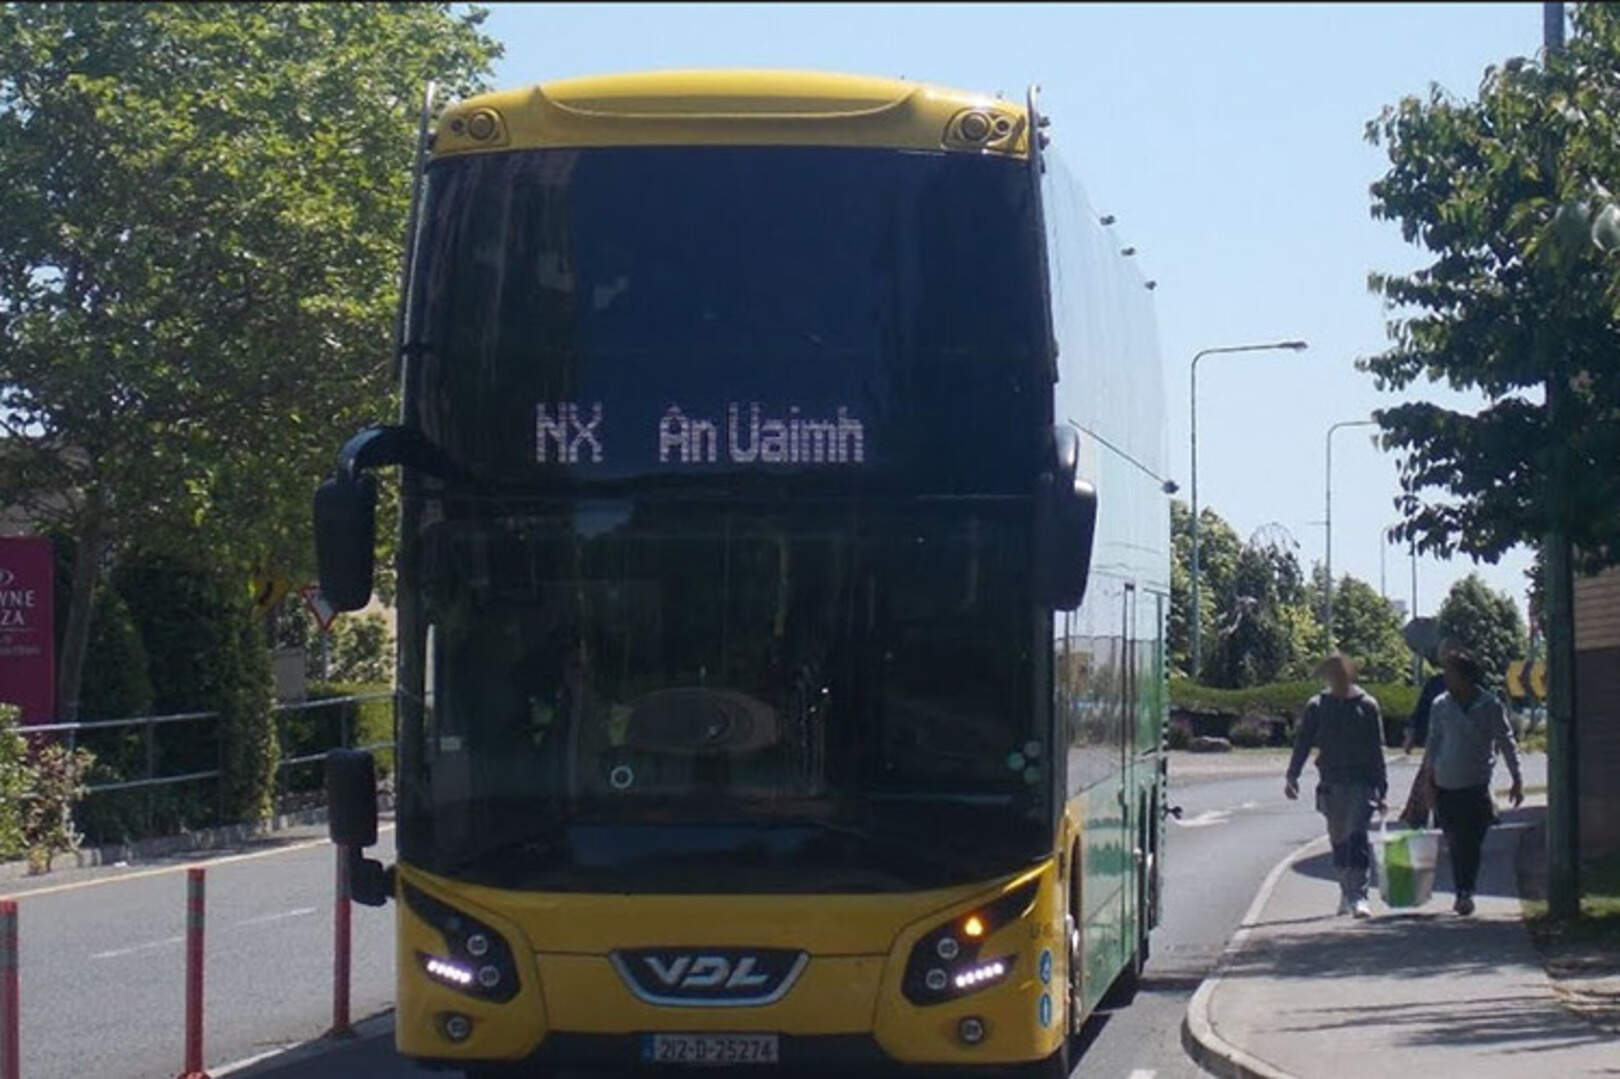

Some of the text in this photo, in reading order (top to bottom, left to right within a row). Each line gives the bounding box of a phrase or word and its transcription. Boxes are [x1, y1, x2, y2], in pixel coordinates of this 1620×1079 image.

[535, 402, 603, 463] NX
[728, 402, 864, 463] Uaimh
[643, 956, 769, 988] VDL
